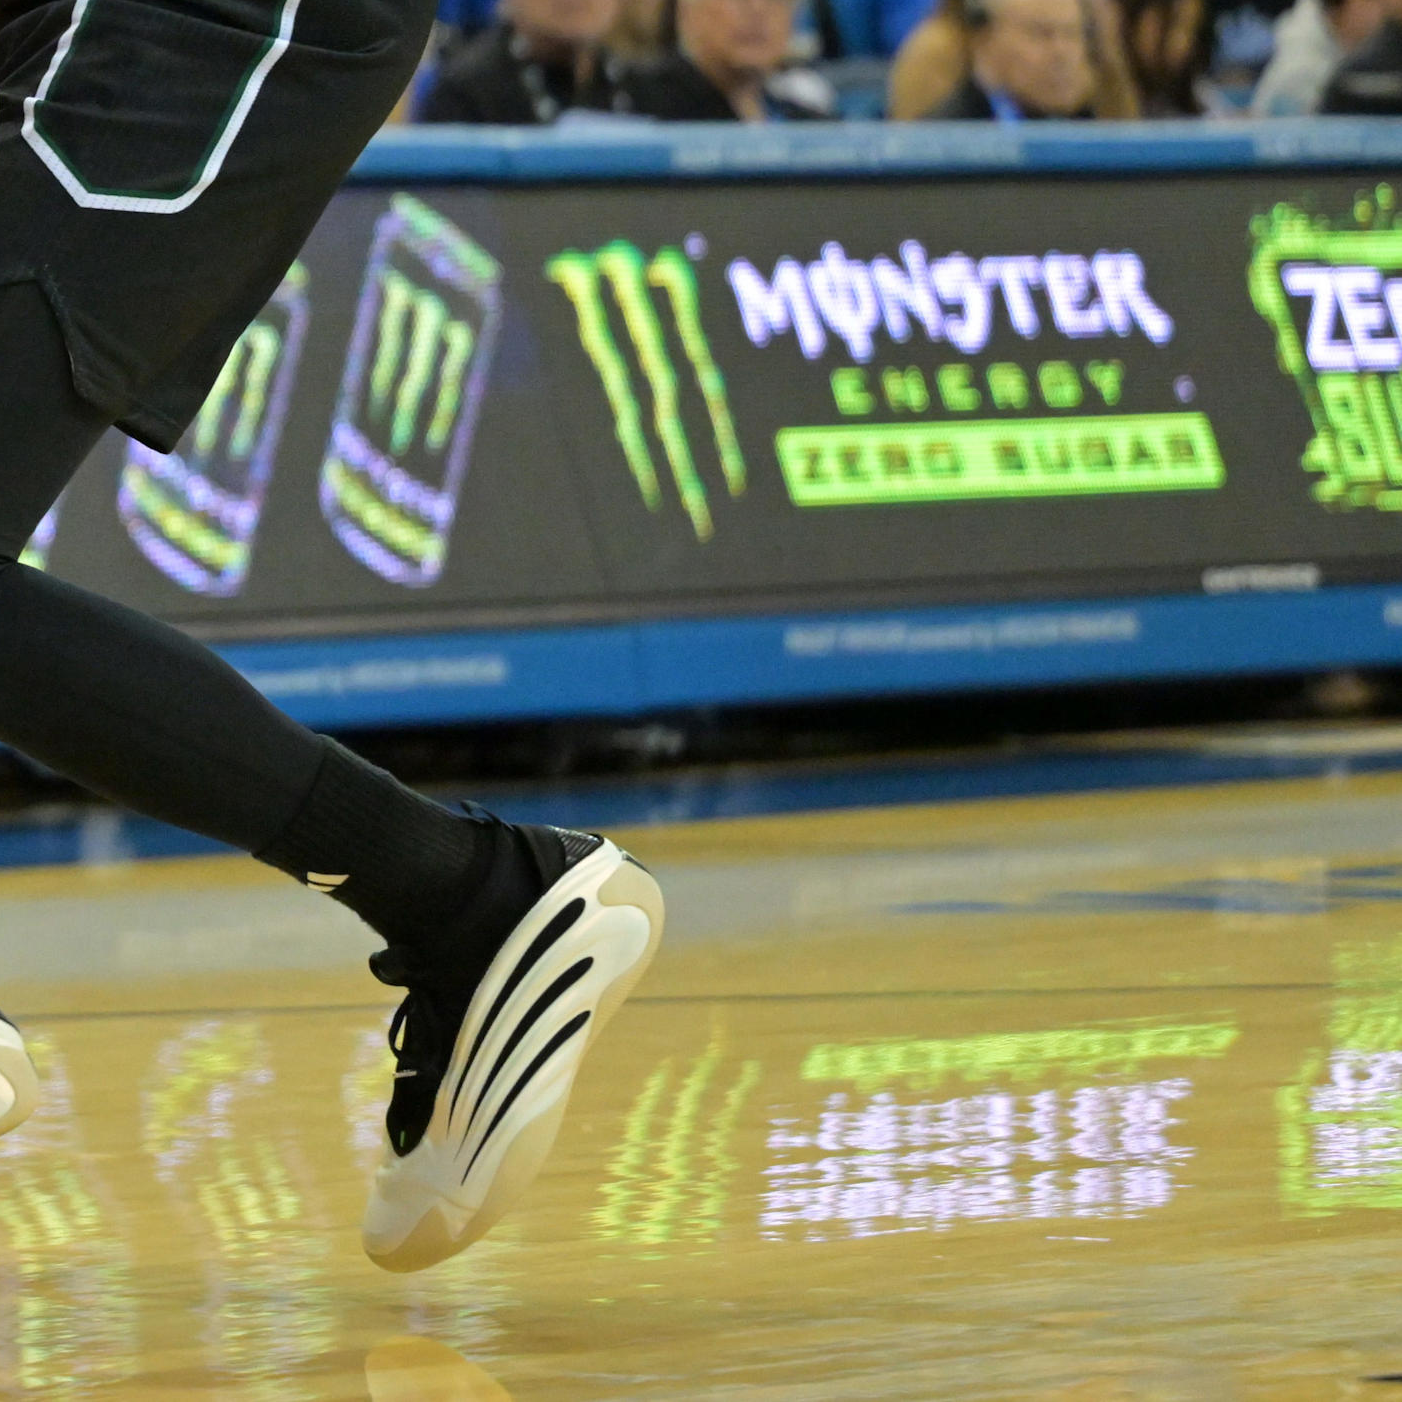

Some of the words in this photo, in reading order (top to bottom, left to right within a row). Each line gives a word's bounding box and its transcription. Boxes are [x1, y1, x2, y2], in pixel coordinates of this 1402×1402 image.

[726, 240, 1175, 363] MONSTER
[1280, 262, 1402, 372] ZE
[830, 360, 1125, 415] ENERGY
[801, 443, 963, 485] ZERO
[995, 432, 1197, 475] SUGAR
